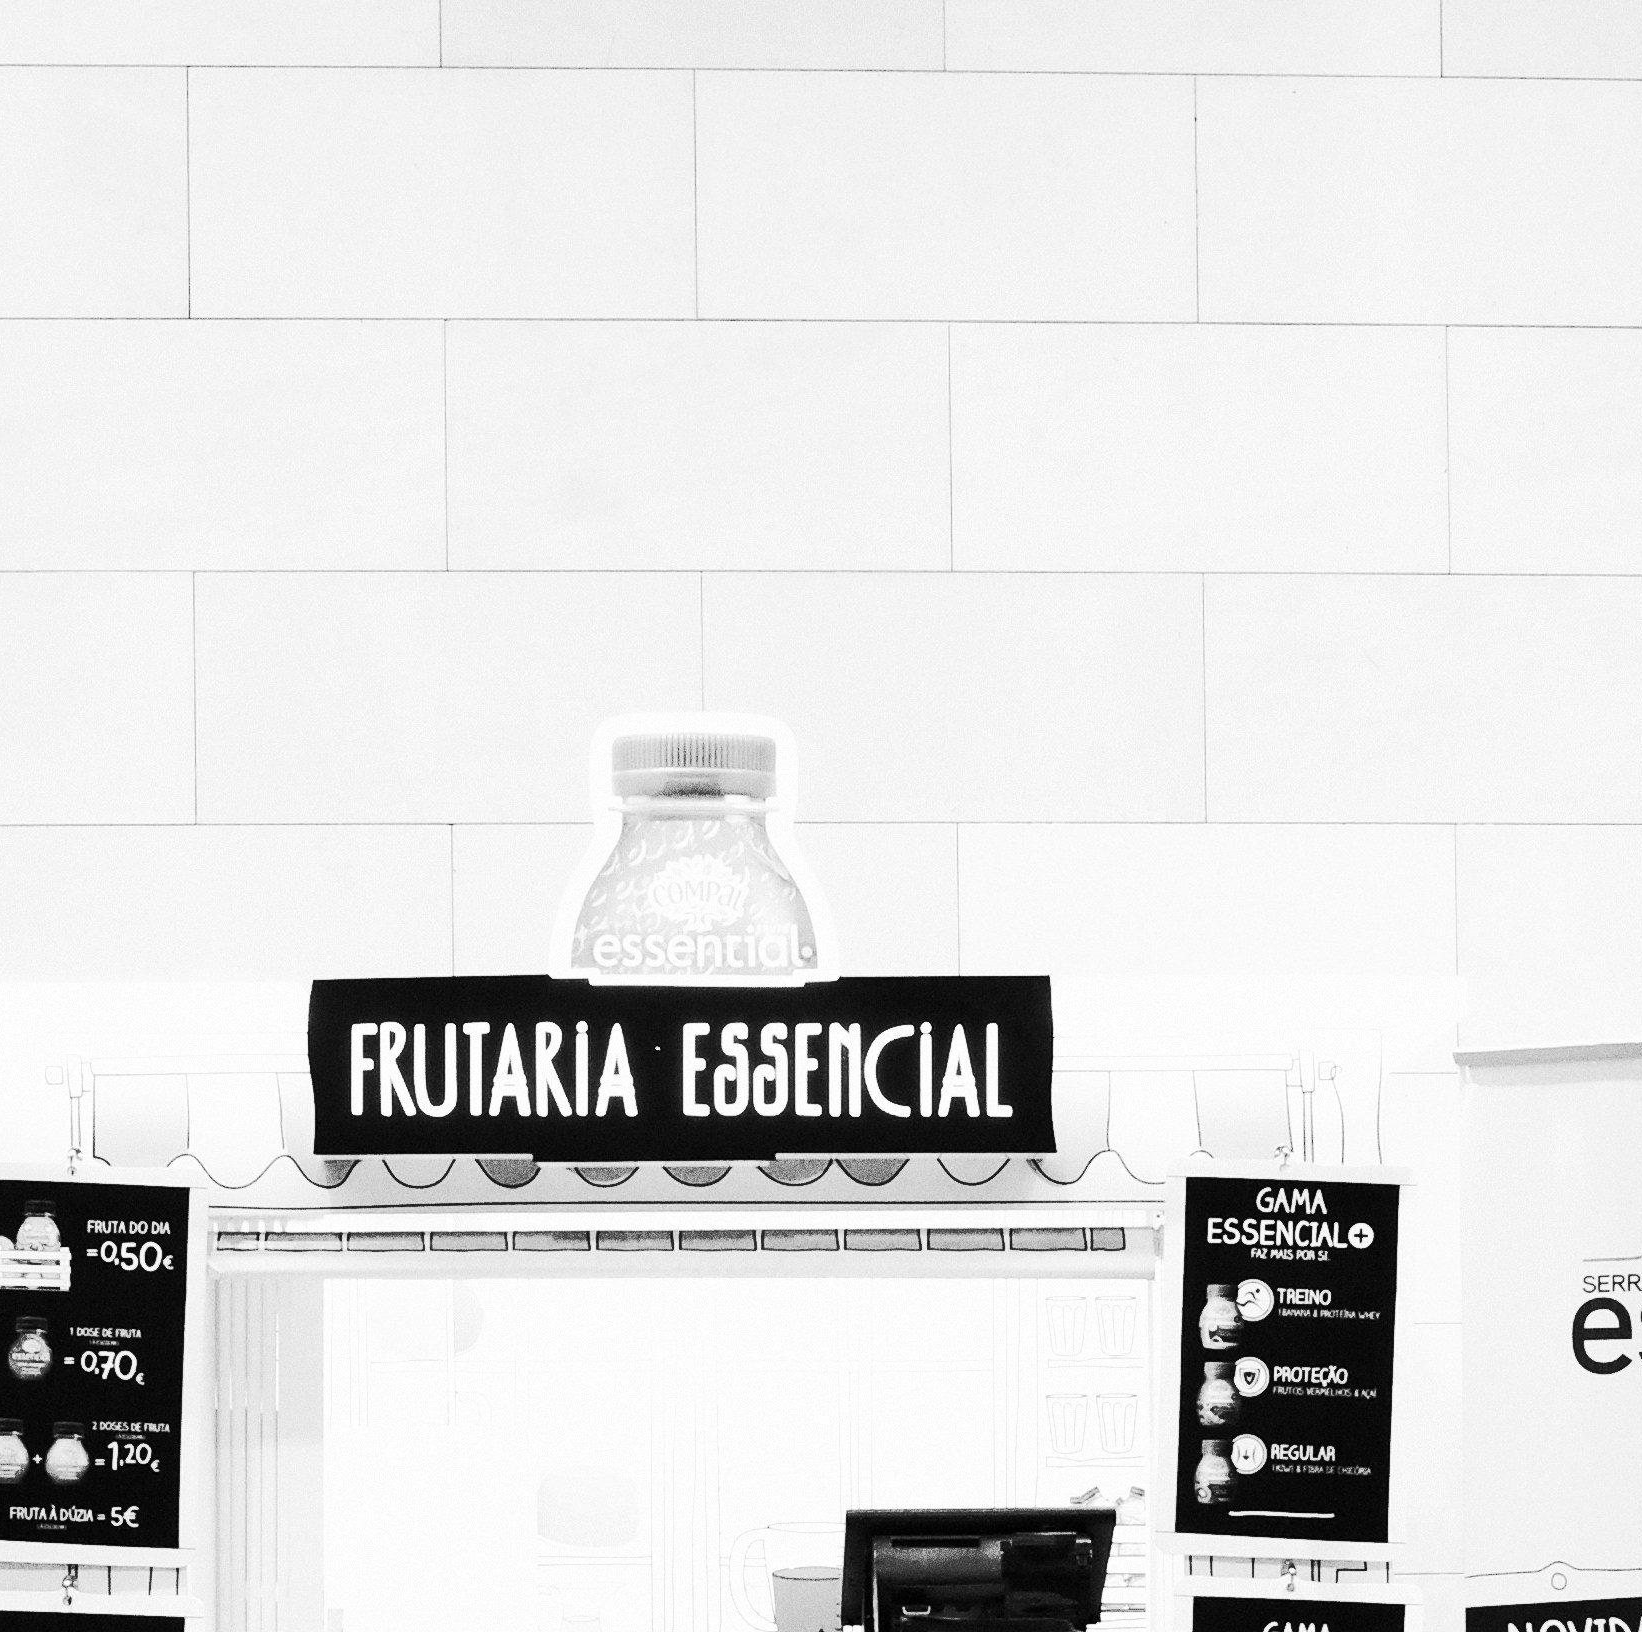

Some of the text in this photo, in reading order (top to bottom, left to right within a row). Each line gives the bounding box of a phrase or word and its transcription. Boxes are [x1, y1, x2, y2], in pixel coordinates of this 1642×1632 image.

[593, 924, 804, 968] essential
[1255, 1186, 1328, 1215] GAMA
[87, 1220, 171, 1235] FRUTA DO DIA
[1250, 1248, 1268, 1260] FAZ
[1270, 1249, 1294, 1260] MAIS
[1296, 1250, 1315, 1261] POR
[1277, 1287, 1332, 1306] TREINO
[76, 1327, 100, 1337] DOSE
[102, 1328, 113, 1338] DE
[115, 1328, 142, 1339] FRUTA
[1273, 1365, 1349, 1388] PROTEÇÃO
[99, 1421, 129, 1431] DOSES
[131, 1422, 142, 1432] DE
[144, 1423, 171, 1433] FRUTA
[1271, 1443, 1336, 1462] REGULAR
[9, 1506, 48, 1521] FRUTA
[49, 1504, 59, 1522] À
[59, 1504, 95, 1523] DÚZIA
